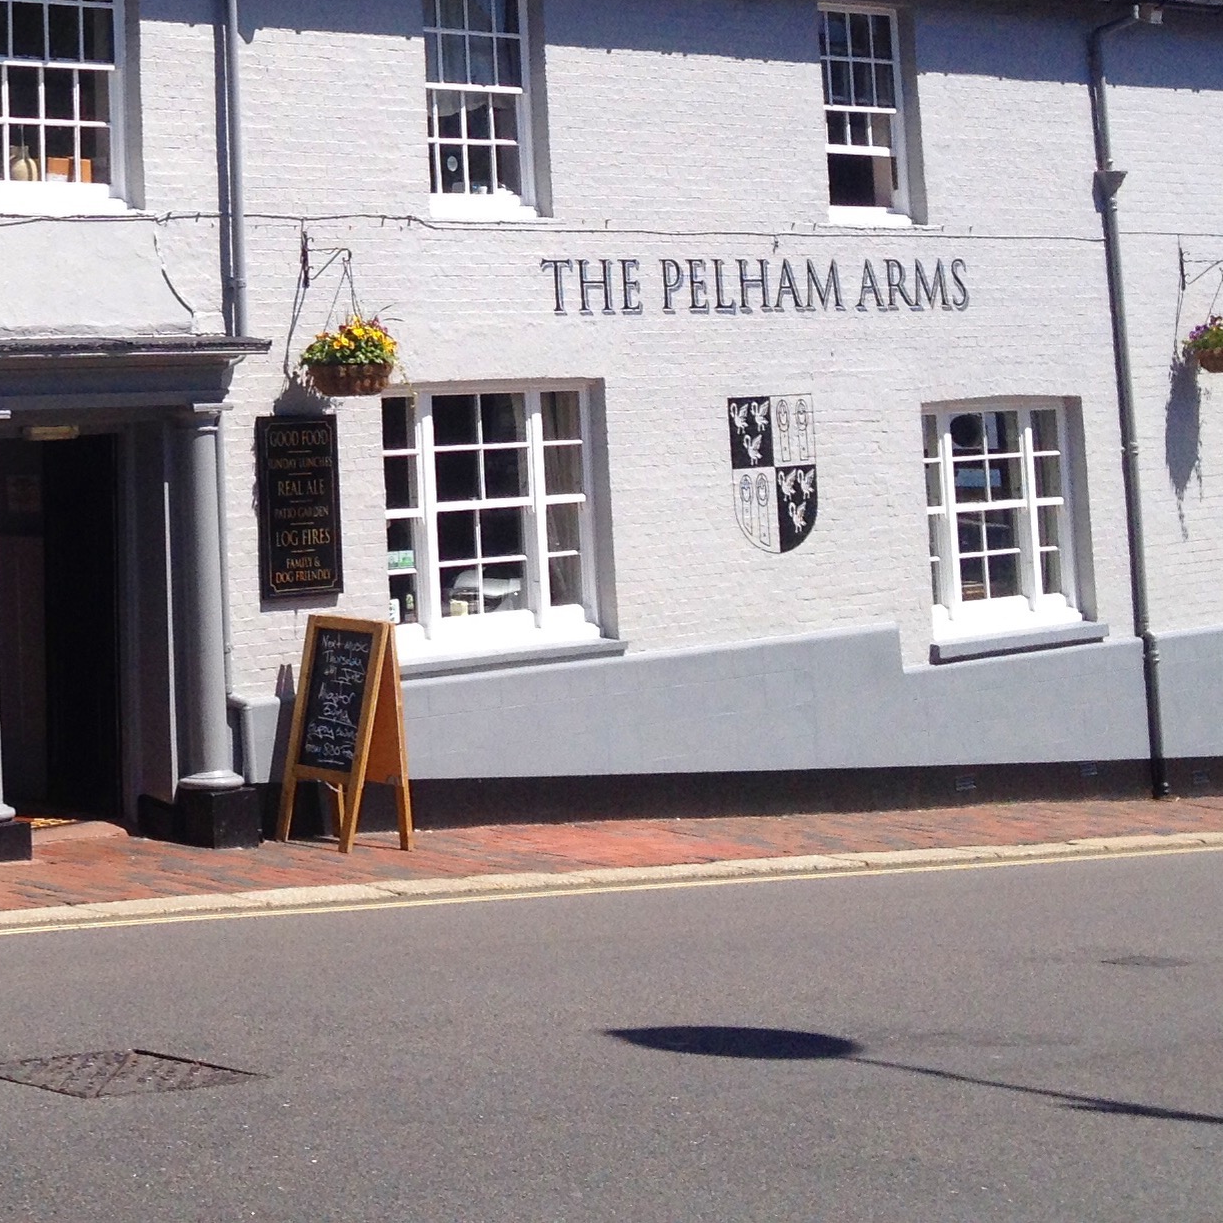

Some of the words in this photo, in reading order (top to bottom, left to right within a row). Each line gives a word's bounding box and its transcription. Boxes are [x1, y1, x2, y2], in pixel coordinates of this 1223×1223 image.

[540, 257, 643, 316] THE
[659, 257, 847, 315] PELHAM
[855, 257, 970, 313] ARMS
[269, 430, 299, 446] GOOD
[301, 429, 328, 445] FOOD
[277, 480, 303, 496] REAL
[307, 478, 326, 494] ALE
[276, 530, 299, 547] LOG
[302, 528, 331, 545] FIRES
[286, 556, 312, 569] FAMILY
[313, 556, 321, 567] &
[275, 570, 294, 584] DOG
[295, 568, 332, 583] FRIENDLY
